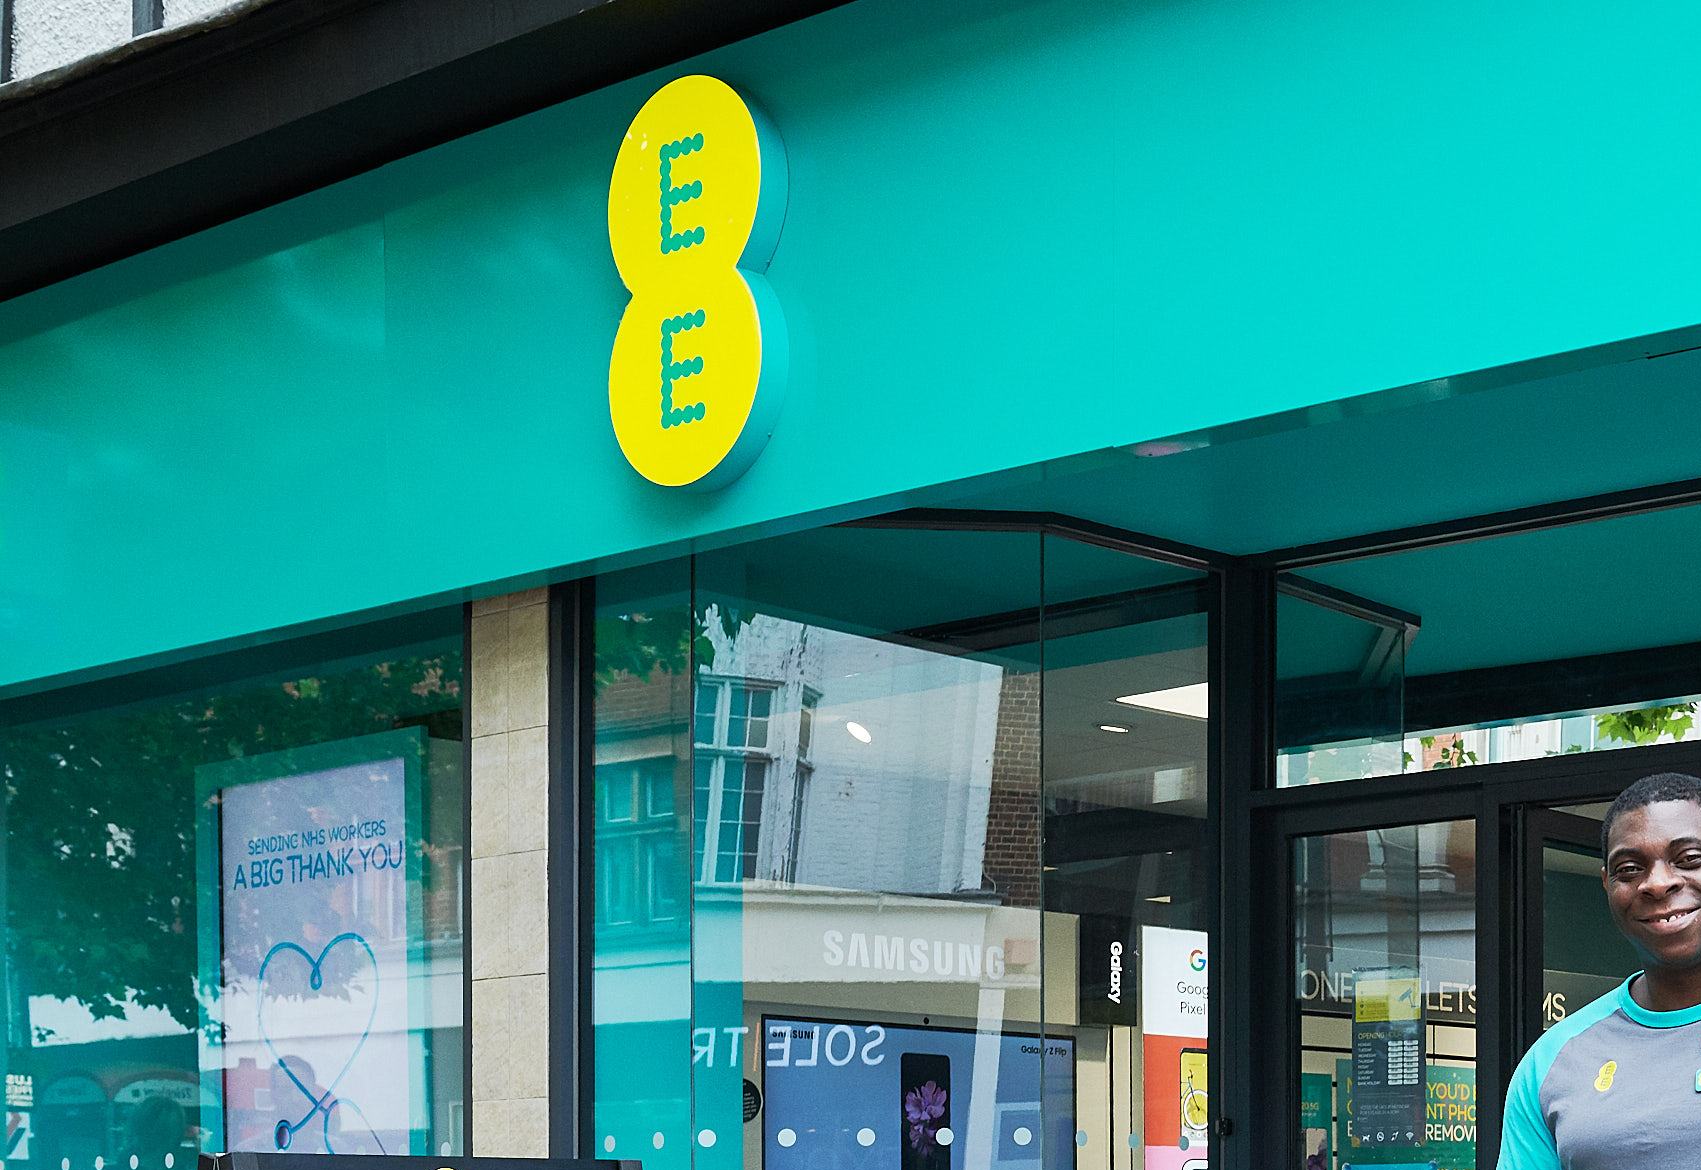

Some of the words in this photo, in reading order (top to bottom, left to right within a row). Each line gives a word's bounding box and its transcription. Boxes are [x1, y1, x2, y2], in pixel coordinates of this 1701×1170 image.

[248, 833, 298, 855] SENDING
[301, 829, 325, 848] NHS
[328, 819, 386, 843] WORKERS
[233, 864, 247, 890] A
[251, 858, 283, 888] BIG
[287, 848, 354, 884] THANK
[358, 840, 403, 872] YOU
[823, 930, 1005, 980] SAMSUNG
[1108, 941, 1123, 1004] Galaxy
[1180, 1001, 1206, 1015] Pixel
[1021, 1045, 1048, 1056] Galay
[1426, 1082, 1470, 1100] YOU'D
[1425, 1123, 1476, 1142] REMOV
